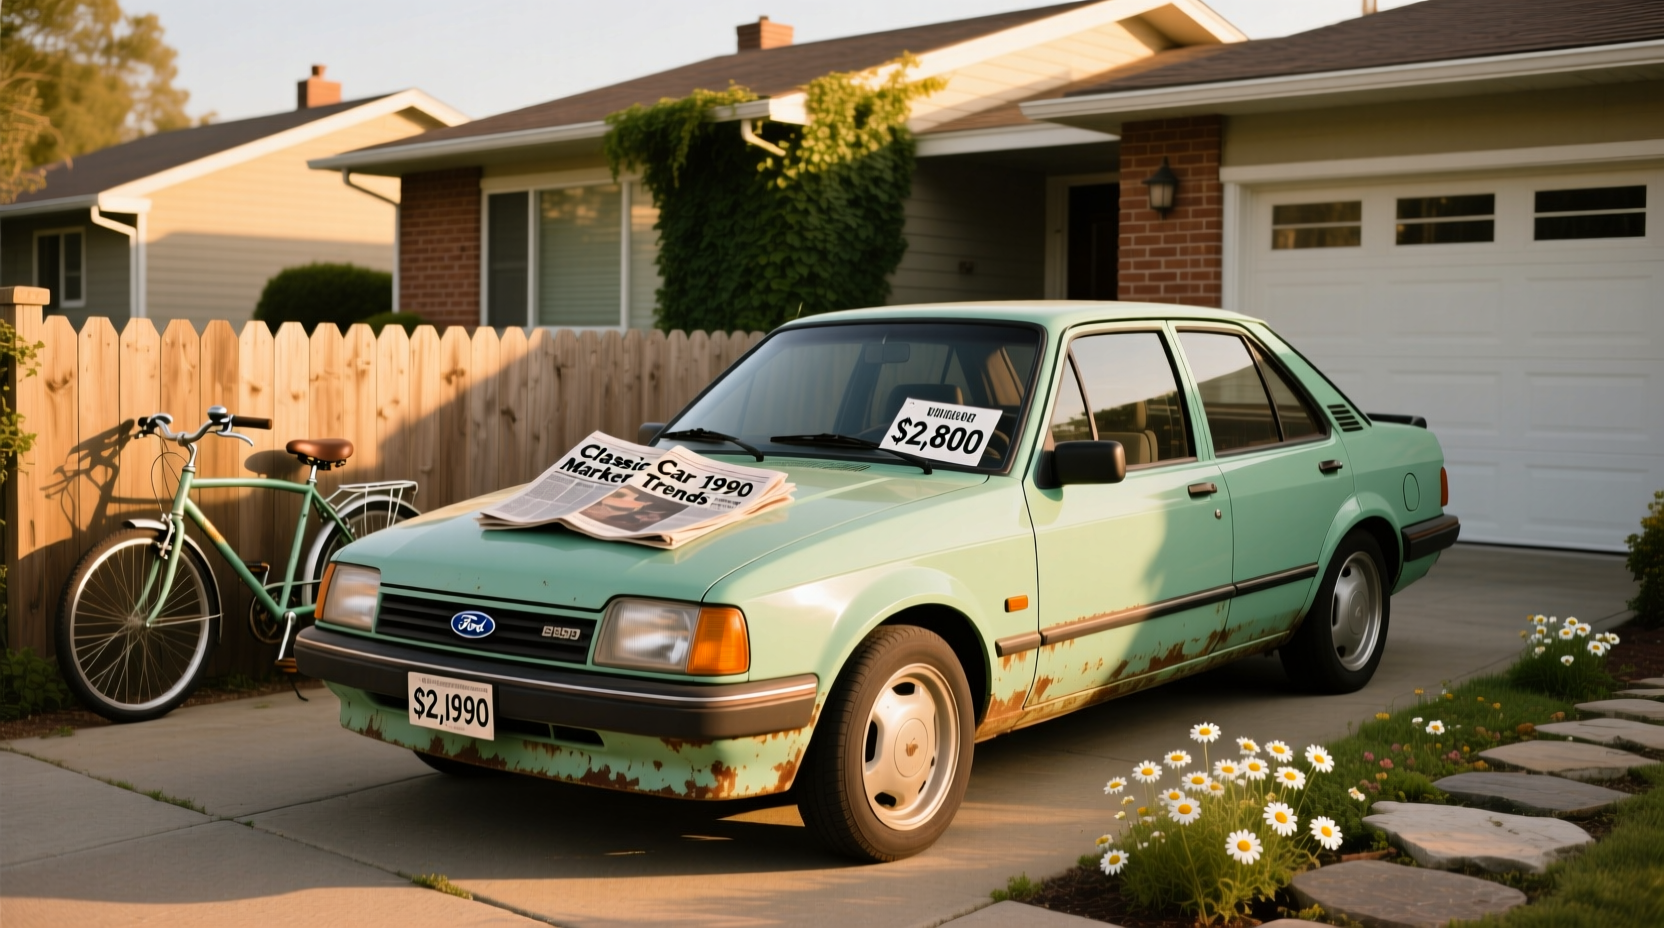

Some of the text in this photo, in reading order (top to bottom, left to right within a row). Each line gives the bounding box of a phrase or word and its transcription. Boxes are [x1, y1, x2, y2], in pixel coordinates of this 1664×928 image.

[891, 416, 984, 455] $2,800
[580, 444, 754, 498] Classic Car 1990
[642, 473, 708, 506] Trends
[458, 613, 488, 633] Ford
[413, 686, 489, 728] $2,1990
